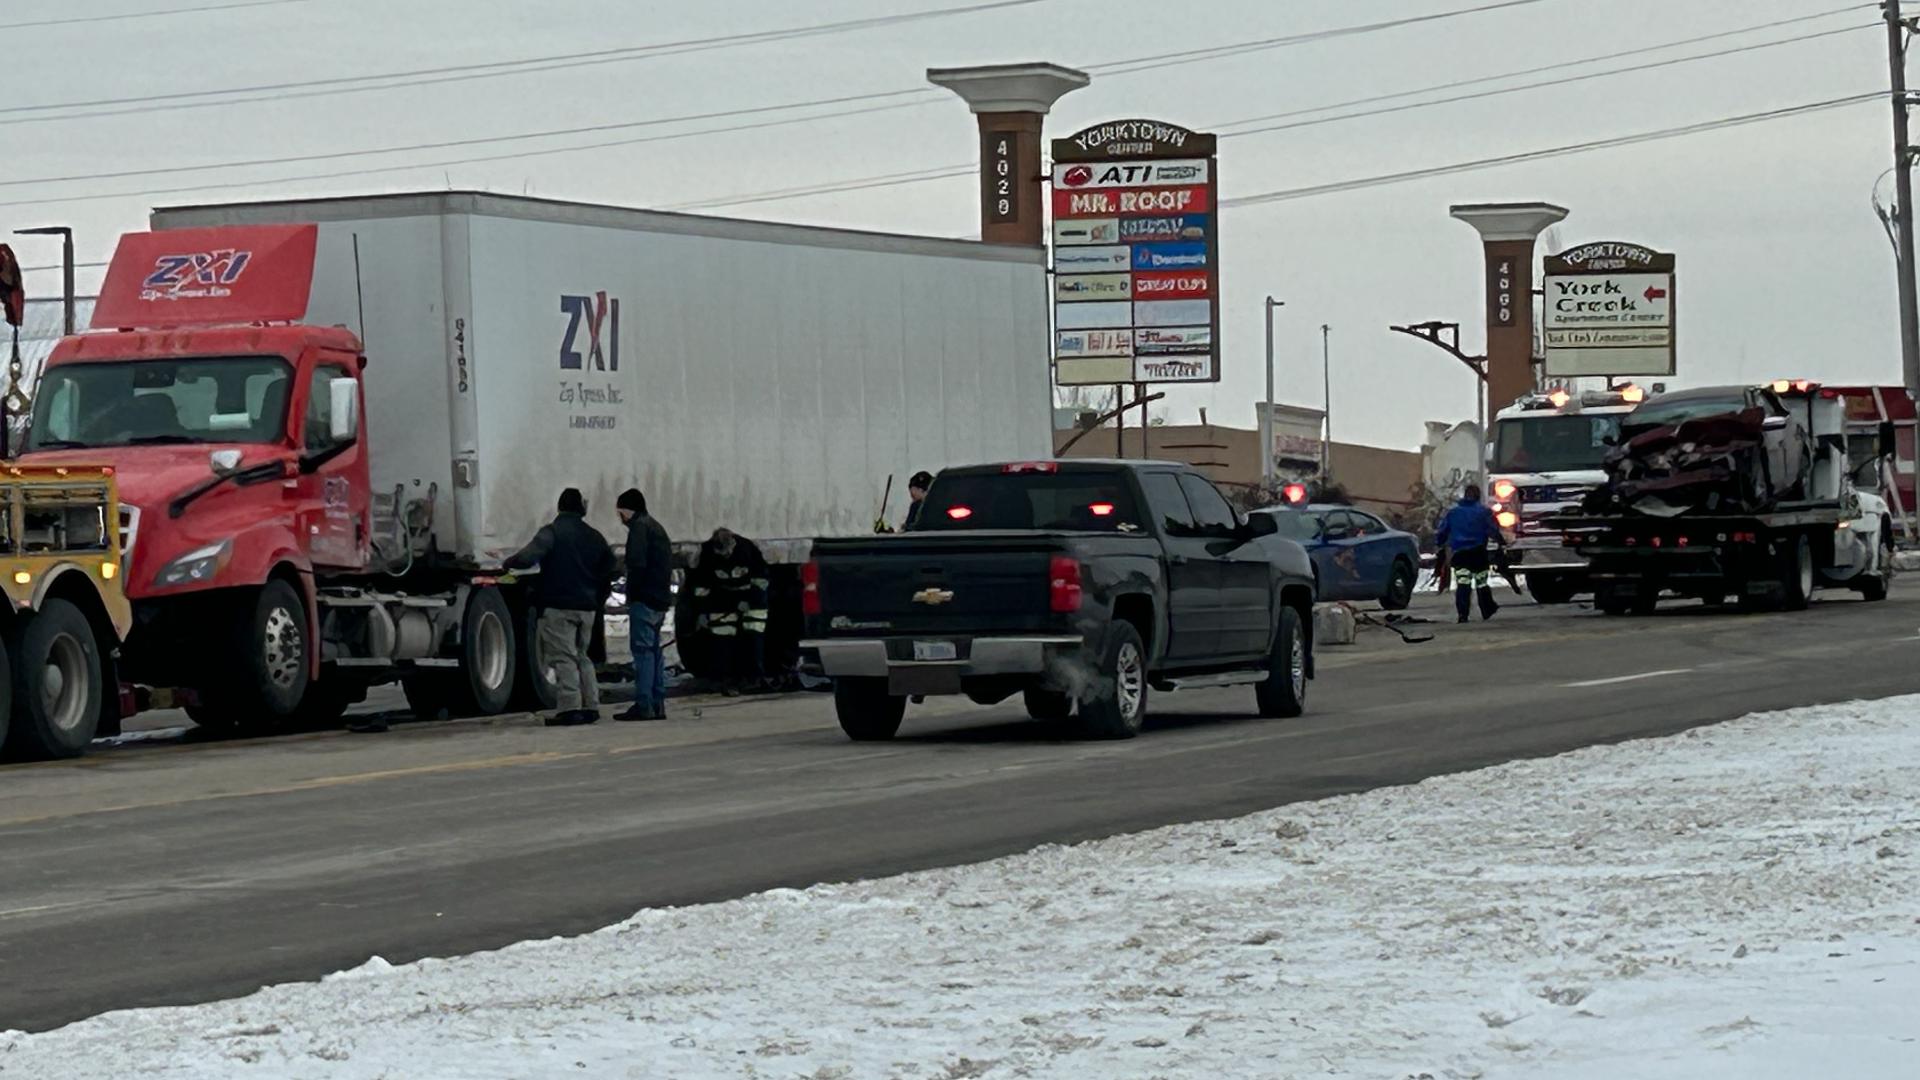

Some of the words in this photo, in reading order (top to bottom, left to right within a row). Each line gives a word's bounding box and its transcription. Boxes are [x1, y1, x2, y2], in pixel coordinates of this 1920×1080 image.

[1075, 122, 1187, 150] YORKTOWN
[1098, 166, 1153, 184] ATI
[1070, 192, 1116, 214] MR.
[1120, 190, 1192, 212] ROOF
[1555, 279, 1622, 296] York
[1555, 296, 1638, 312] Creek
[560, 291, 619, 372] ZXI
